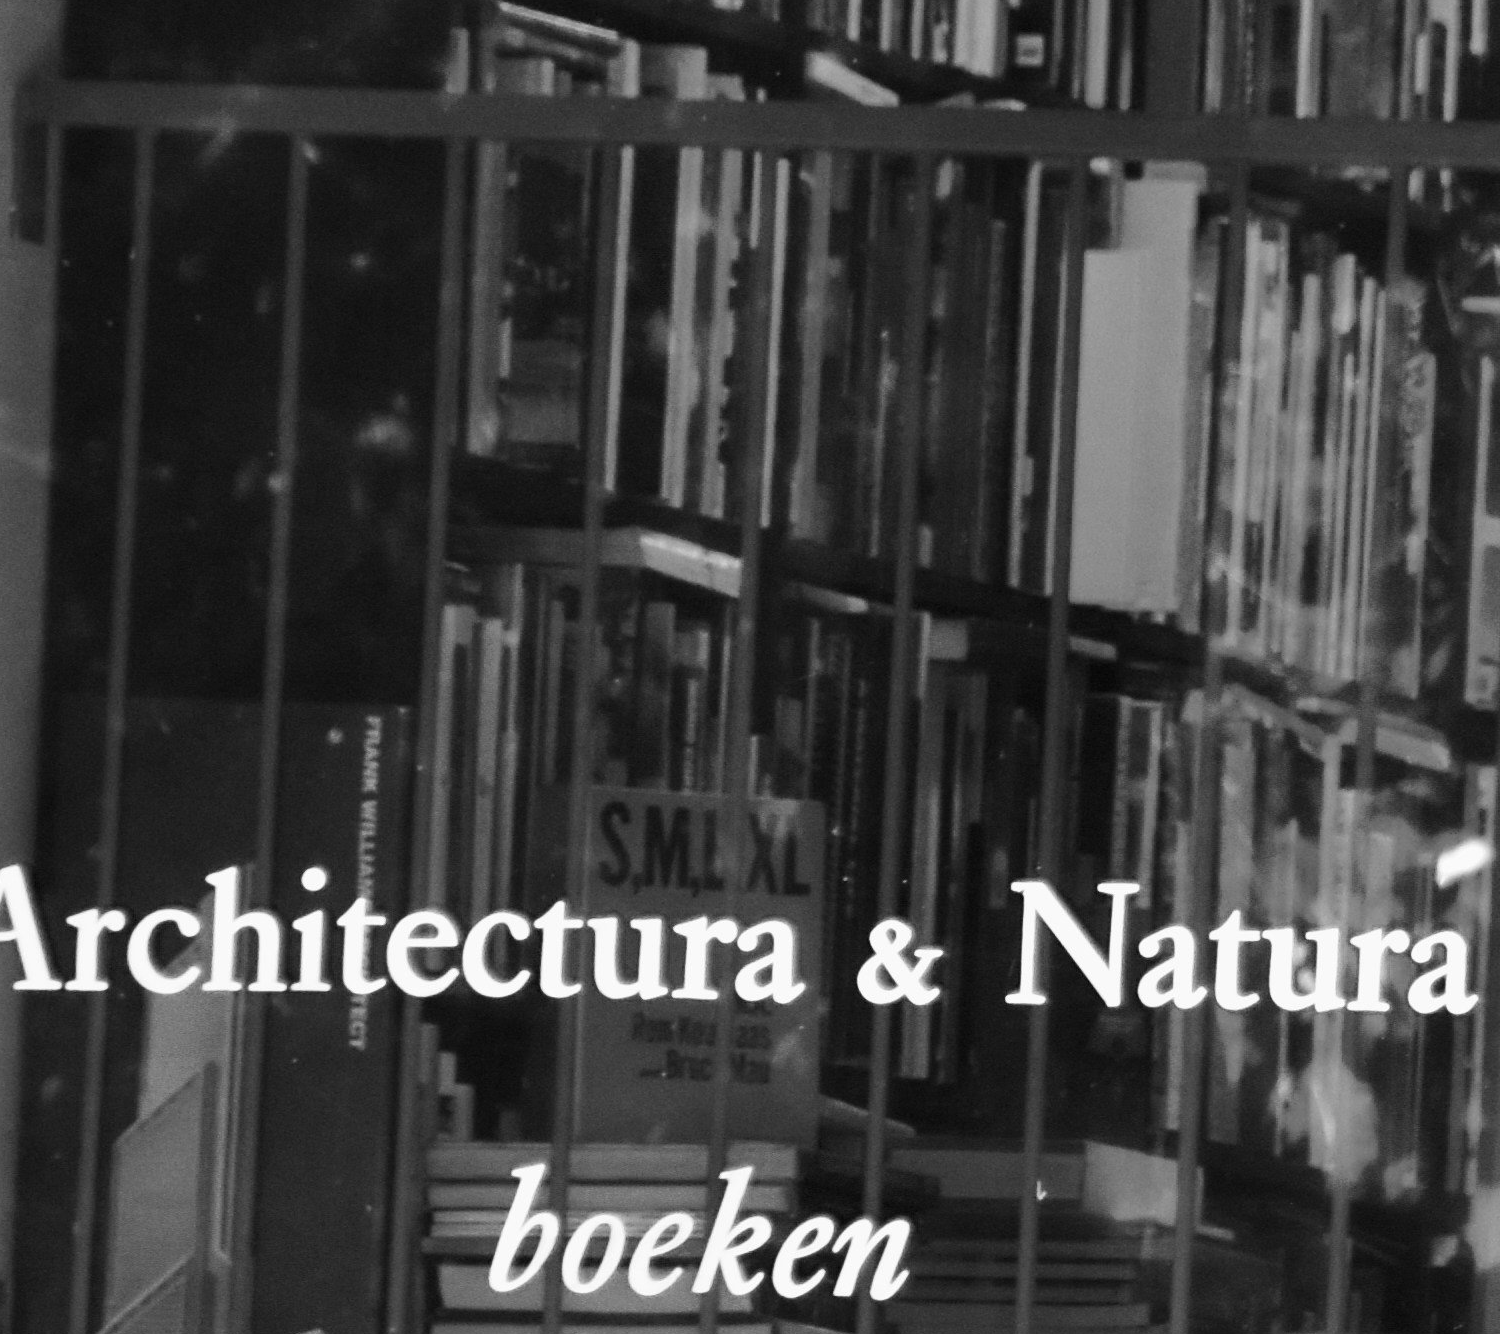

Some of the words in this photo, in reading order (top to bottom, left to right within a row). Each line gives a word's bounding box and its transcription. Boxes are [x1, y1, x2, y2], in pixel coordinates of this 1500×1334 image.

[363, 716, 381, 793] FRANK
[357, 800, 378, 911] WILLIAM
[856, 918, 945, 1007] &
[1004, 880, 1480, 1016] Natura
[488, 1163, 910, 1301] boeken
